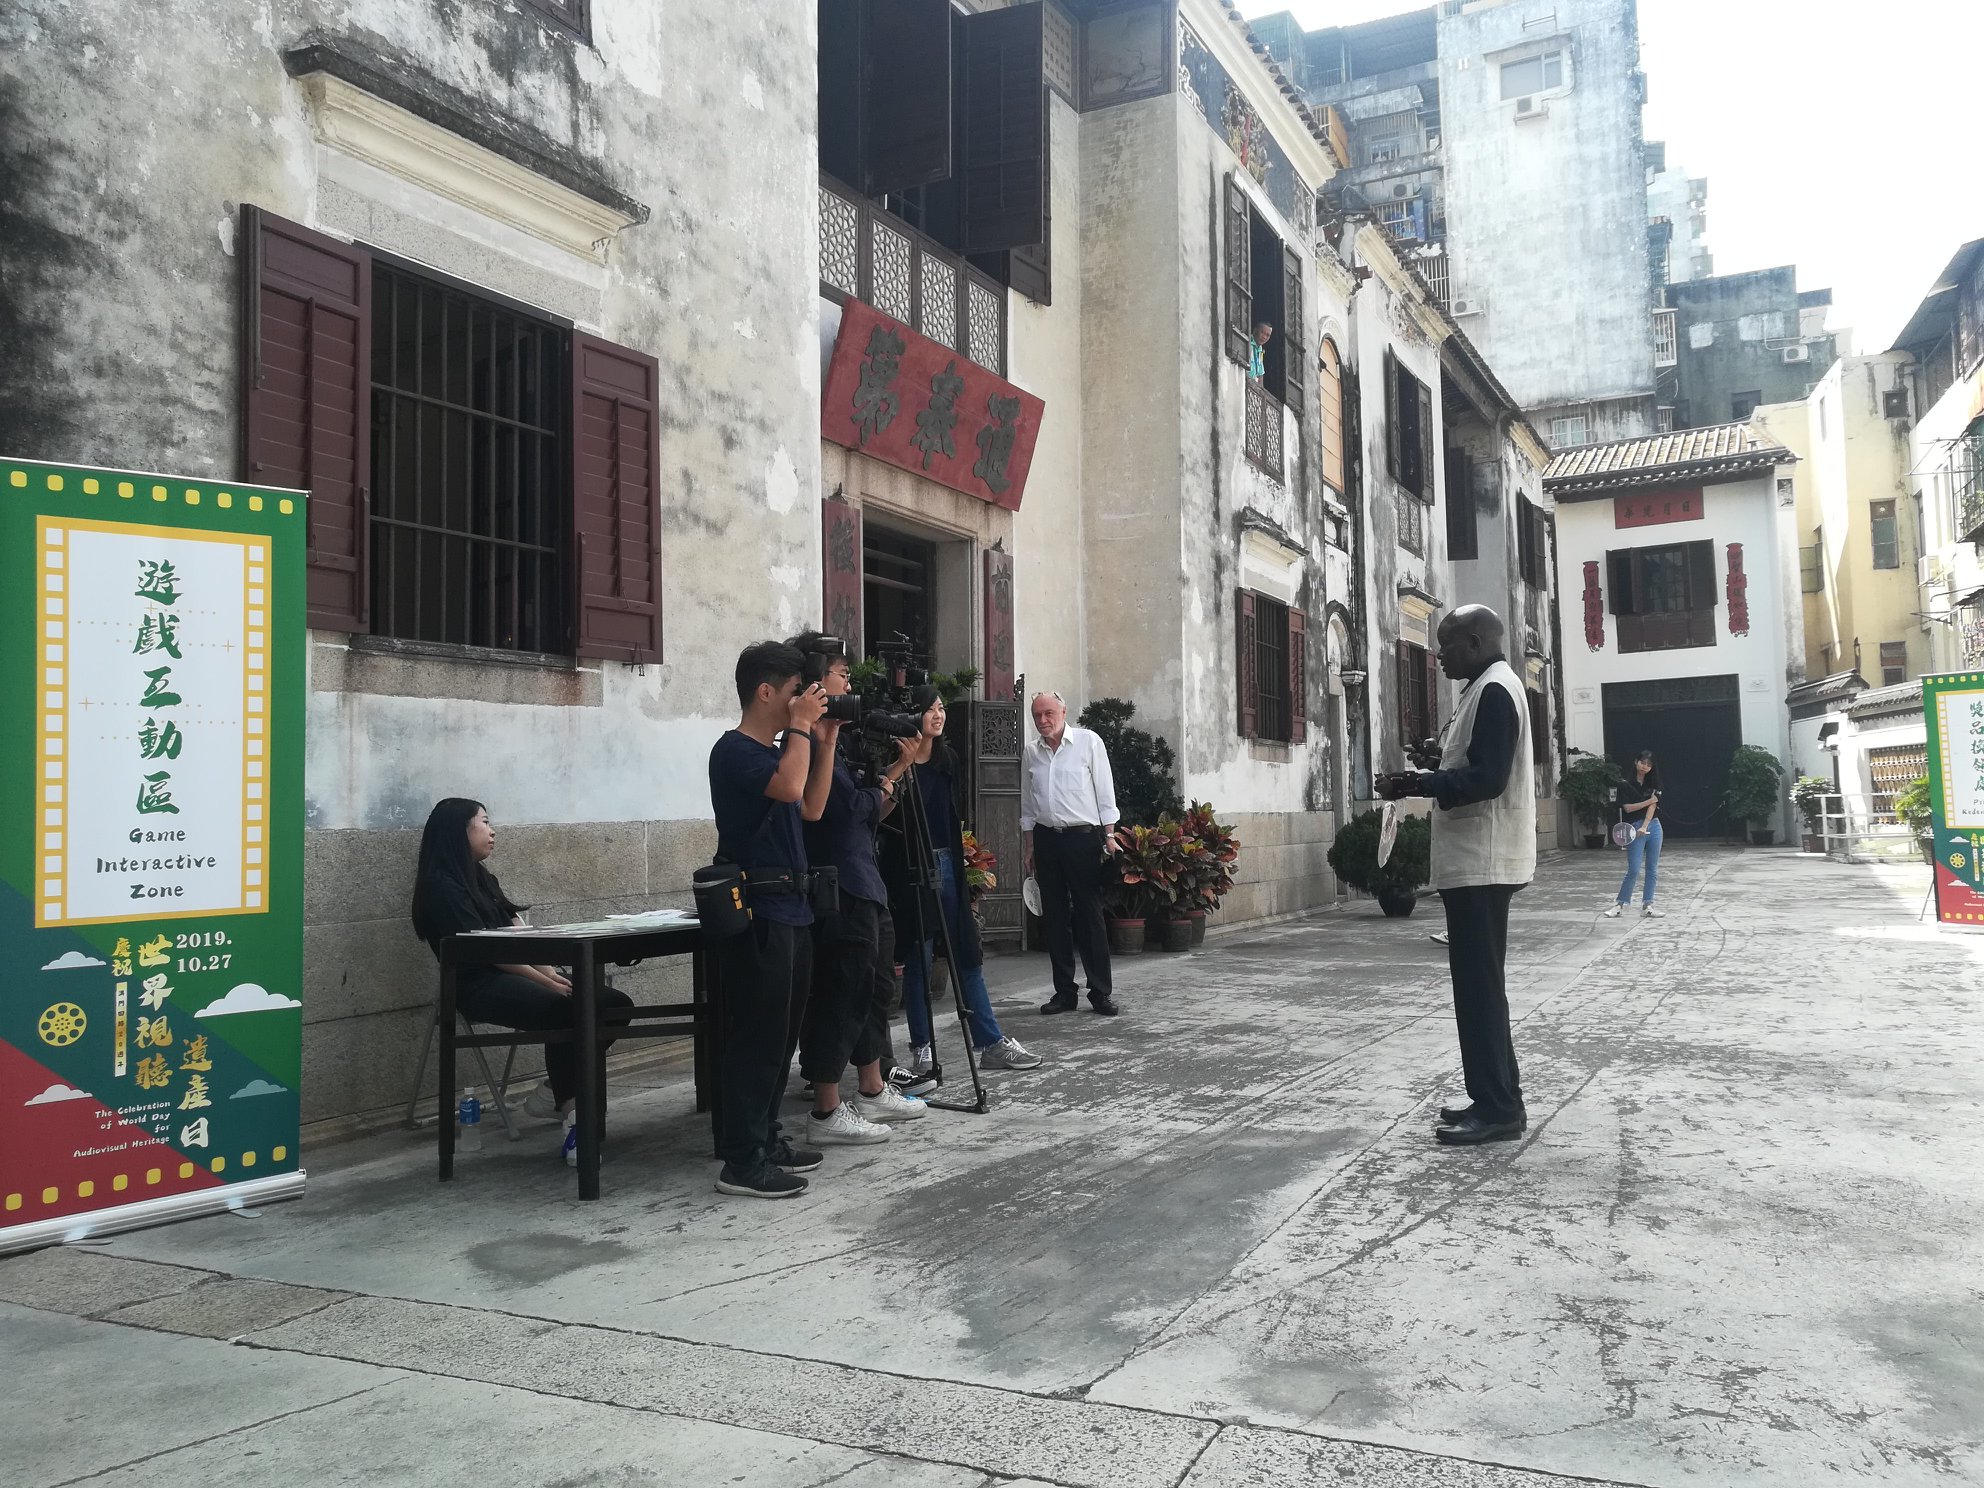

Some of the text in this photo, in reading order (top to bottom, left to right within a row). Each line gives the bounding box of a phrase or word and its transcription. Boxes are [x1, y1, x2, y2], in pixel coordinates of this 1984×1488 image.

[133, 558, 184, 816] 遊戲互動區
[129, 827, 187, 844] Game
[96, 854, 217, 874] Interactive
[130, 884, 185, 900] Zone
[176, 931, 232, 949] 2019.
[112, 937, 133, 977] 慶祝
[177, 954, 232, 973] 10.27
[95, 1101, 171, 1119] The Celebration
[100, 1112, 171, 1130] of World Day
[154, 1124, 171, 1133] for
[73, 1136, 170, 1158] Audiovisual Heritage
